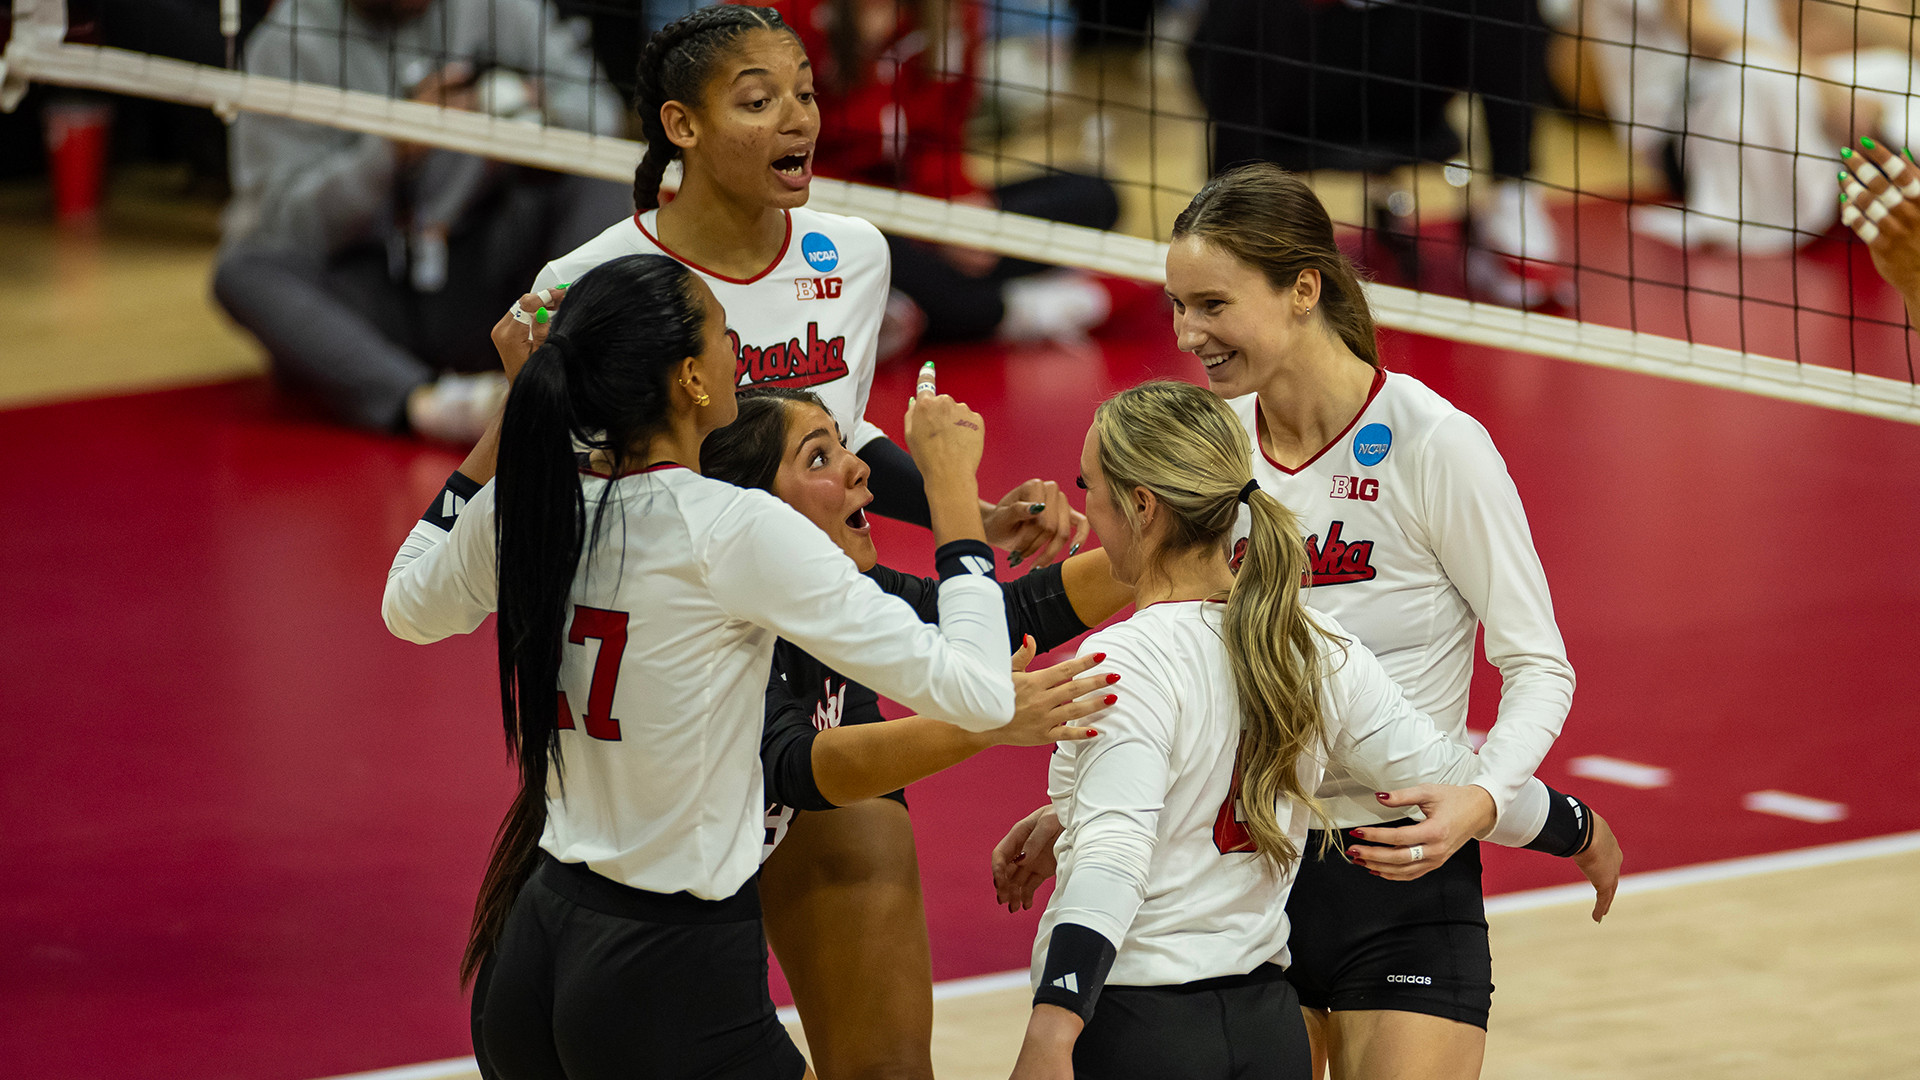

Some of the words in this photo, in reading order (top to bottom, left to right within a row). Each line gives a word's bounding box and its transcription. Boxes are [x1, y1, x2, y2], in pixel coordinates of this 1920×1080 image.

[808, 249, 838, 263] NCAA
[725, 321, 849, 390] raska
[1358, 443, 1389, 455] NCAA
[557, 604, 630, 742] 7
[1386, 974, 1432, 986] adidas
